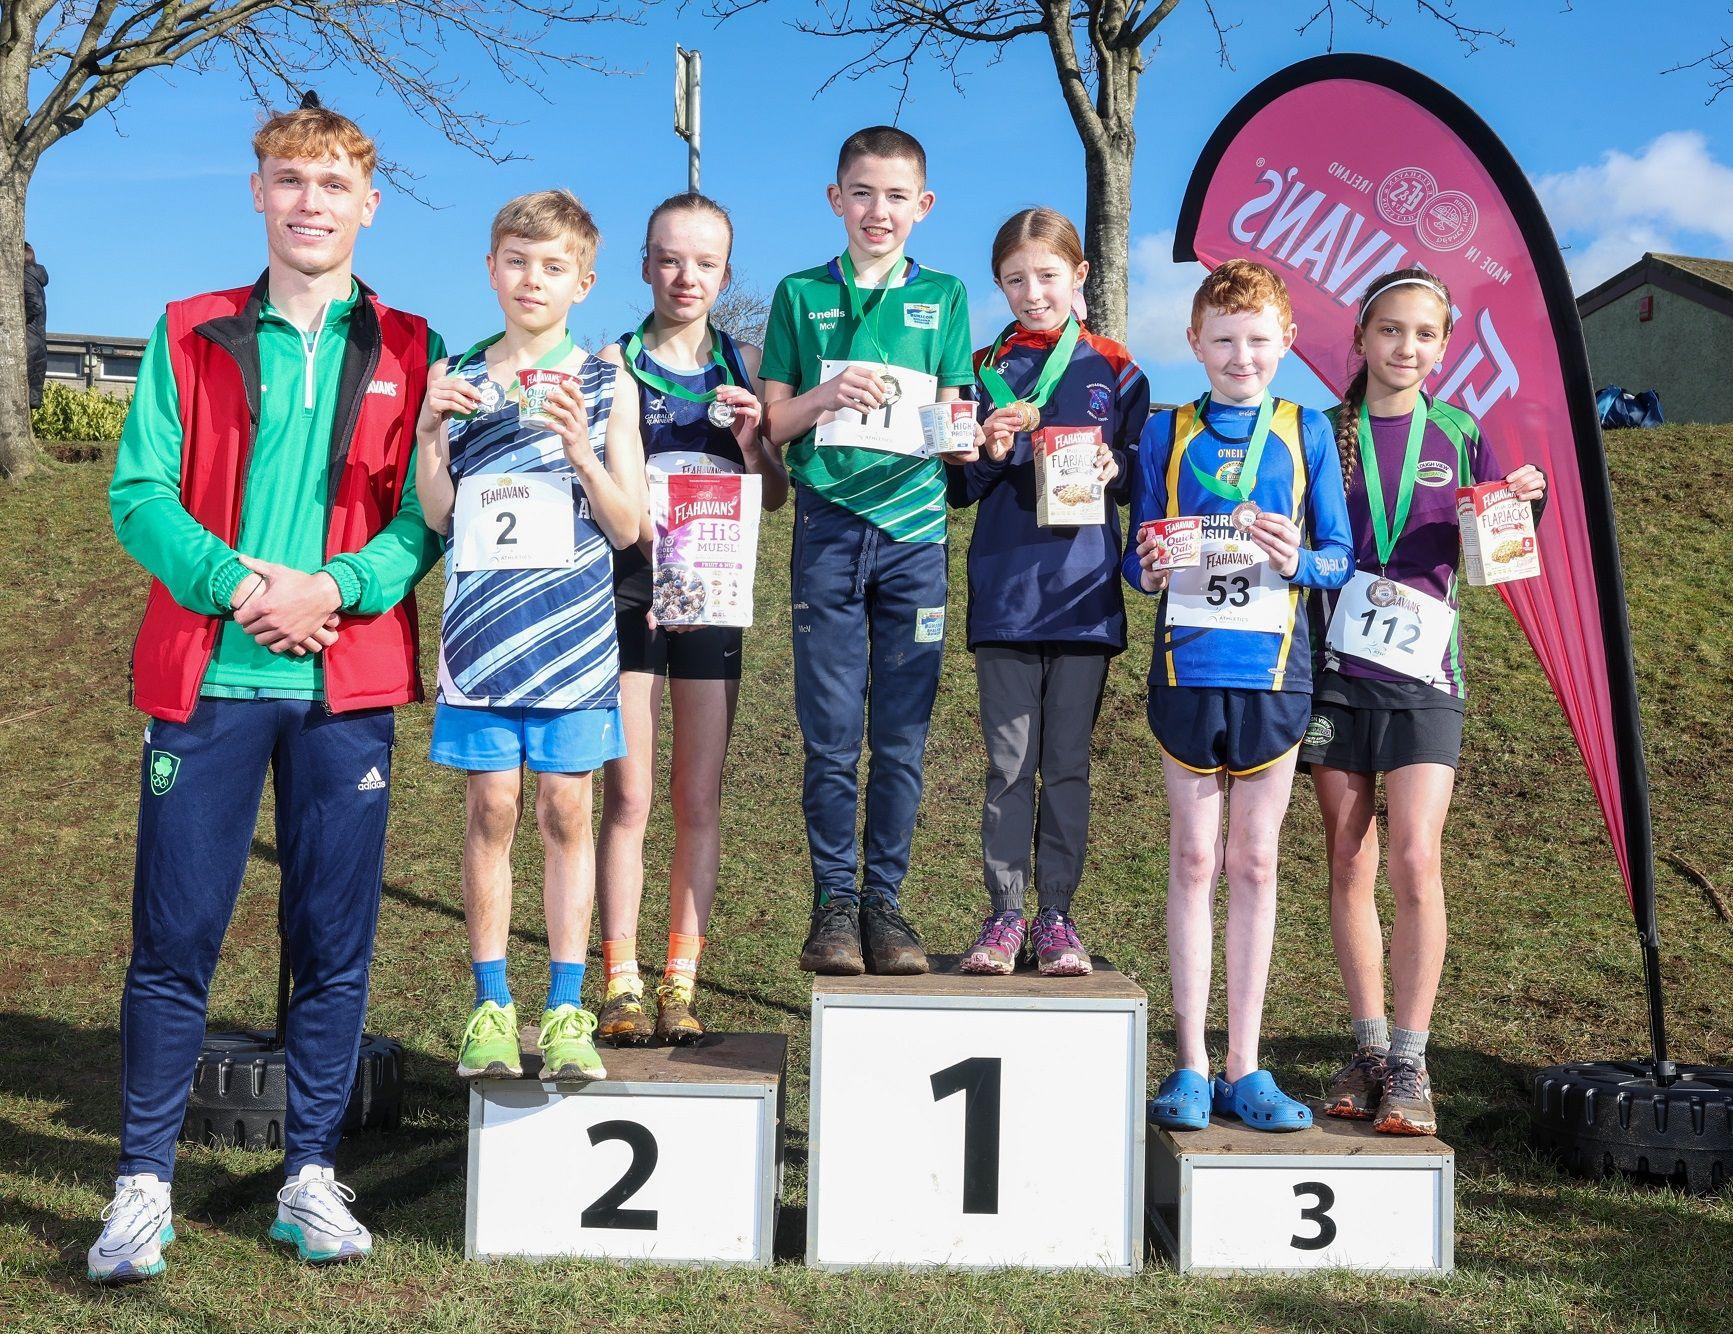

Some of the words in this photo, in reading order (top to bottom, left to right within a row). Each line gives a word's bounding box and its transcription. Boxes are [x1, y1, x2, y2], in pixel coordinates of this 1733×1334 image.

[819, 322, 837, 331] McV
[1217, 448, 1248, 458] O'NEIL
[480, 485, 530, 508] FLAHAVAN'S
[674, 501, 734, 525] FLAHAVAN'S
[1482, 506, 1530, 529] FLAPJACKS
[496, 511, 518, 545] 2
[697, 543, 742, 553] MUESL
[1167, 533, 1194, 547] Quick
[1171, 544, 1192, 555] Oats
[1206, 552, 1254, 570] FLAHAVAN'S
[1206, 575, 1250, 607] 53
[1360, 608, 1421, 655] 112
[357, 780, 386, 791] adidas
[931, 1058, 1001, 1214] 1
[581, 1119, 658, 1230] 2
[1291, 1182, 1337, 1250] 3
